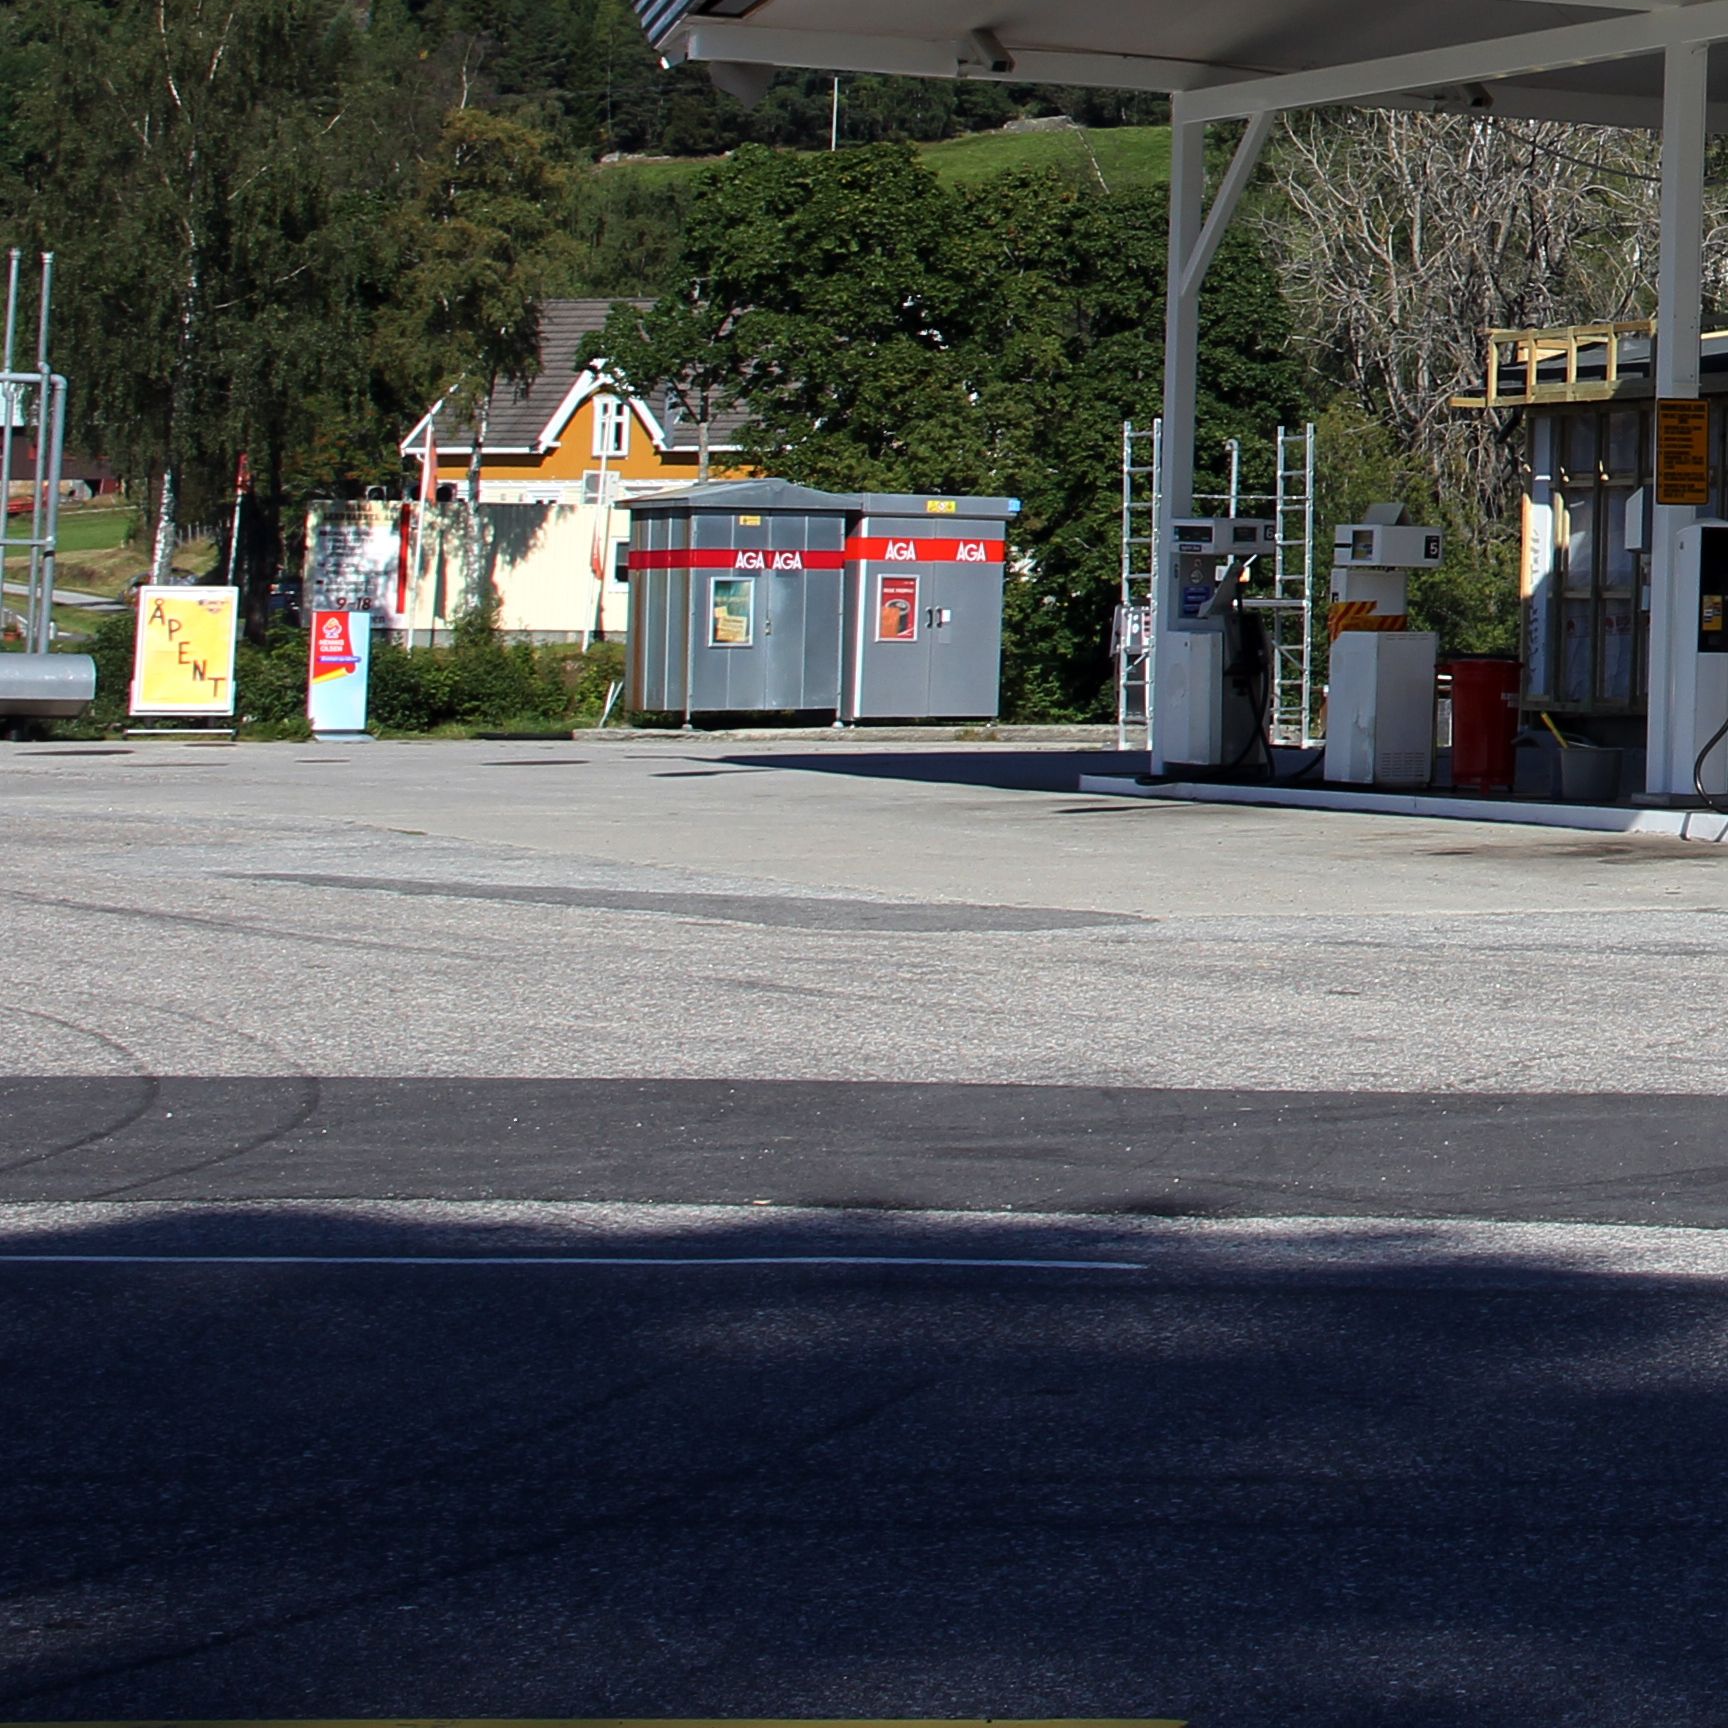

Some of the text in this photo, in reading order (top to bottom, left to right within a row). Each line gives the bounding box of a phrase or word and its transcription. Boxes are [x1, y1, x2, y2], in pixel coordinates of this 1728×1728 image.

[1266, 526, 1275, 539] 6
[885, 539, 916, 560] AGA
[956, 540, 986, 561] AGA
[1430, 542, 1438, 555] 5
[735, 551, 765, 569] AGA
[772, 551, 803, 570] AGA
[148, 598, 226, 698] ÅPENT
